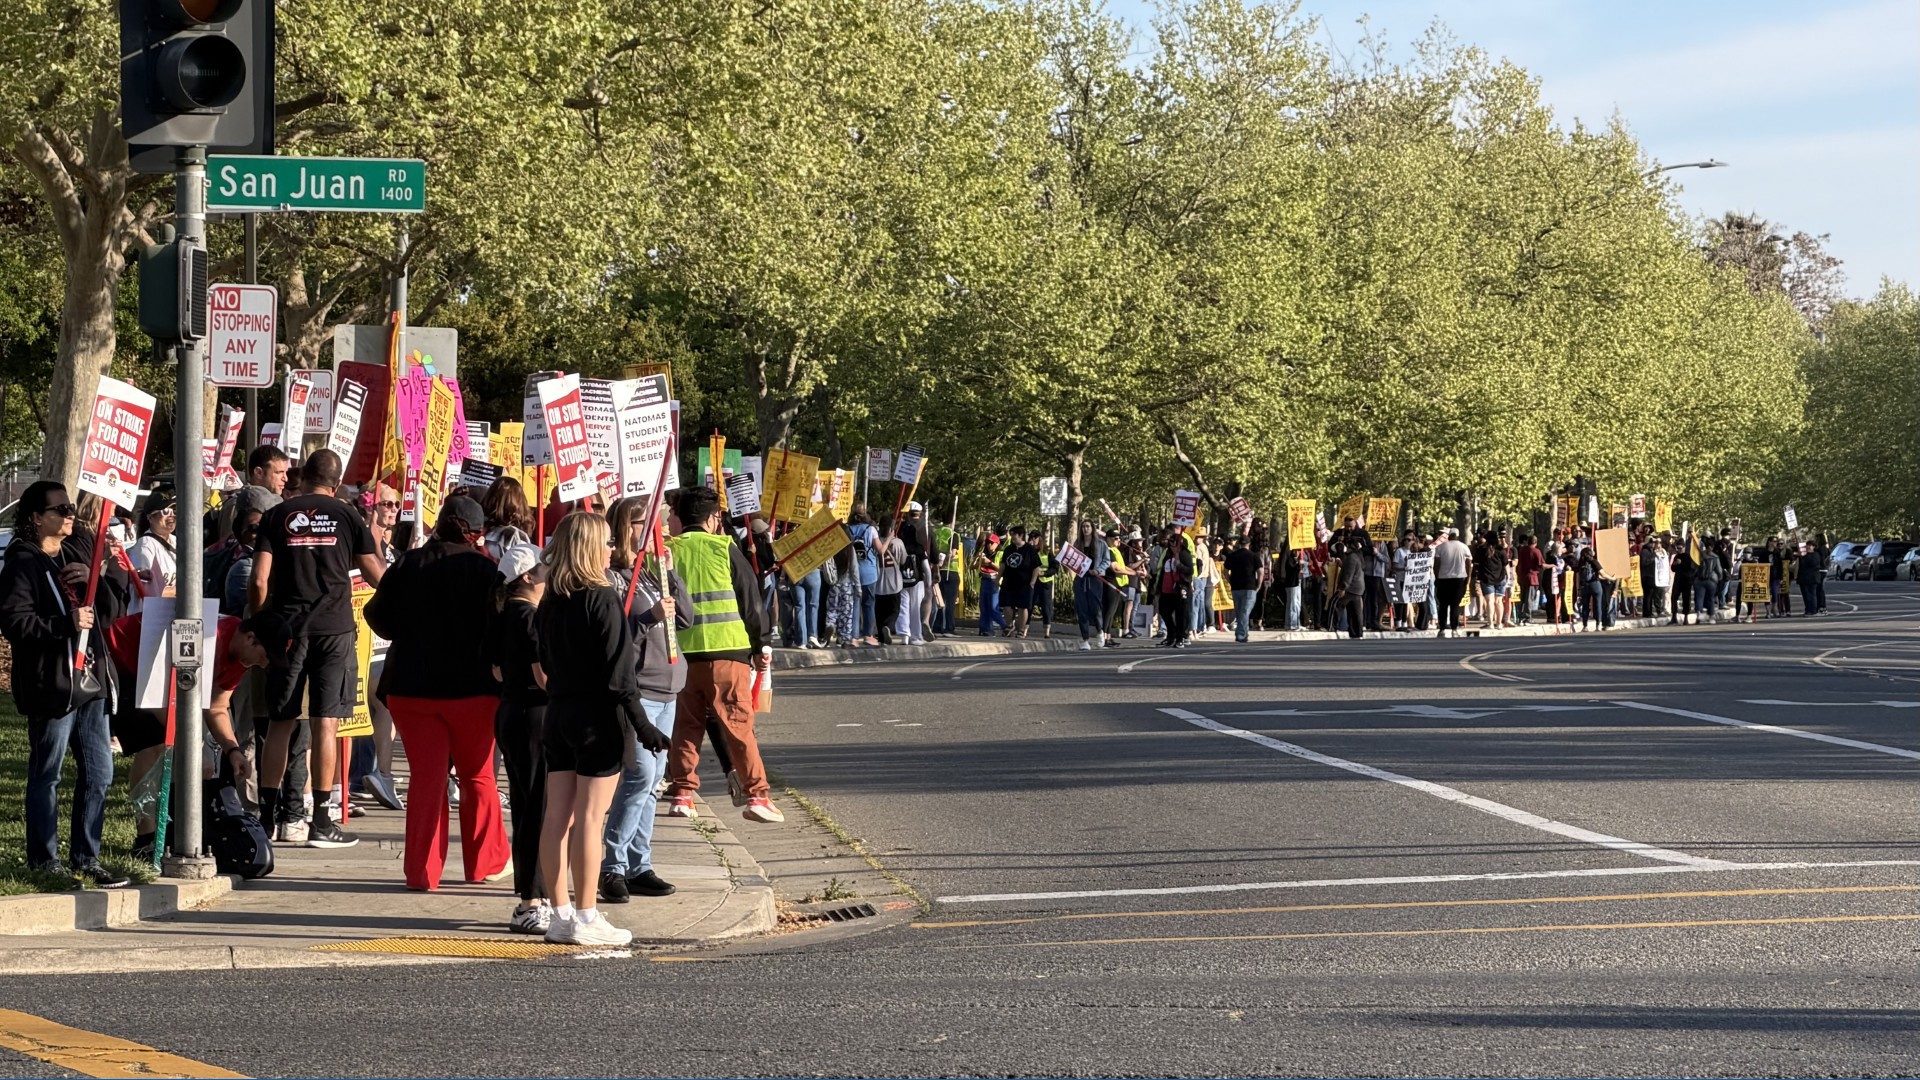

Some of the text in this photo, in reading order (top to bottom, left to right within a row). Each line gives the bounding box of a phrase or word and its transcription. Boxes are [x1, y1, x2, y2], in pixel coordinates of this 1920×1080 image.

[220, 165, 365, 200] San Juan
[389, 169, 406, 183] RD
[381, 187, 412, 201] 1400
[214, 290, 239, 309] NO
[214, 313, 270, 332] STOPPING
[225, 339, 257, 354] ANY
[222, 361, 258, 377] TIME
[310, 387, 330, 399] PPING
[306, 403, 321, 413] NY
[583, 405, 614, 413] TOMAS
[97, 400, 145, 437] ON STRIKE
[306, 417, 323, 427] IME
[548, 407, 562, 426] ON
[585, 414, 614, 422] DENTS
[624, 412, 666, 427] NATOMAS
[97, 422, 138, 455] FOR OUR
[527, 433, 549, 441] NATOMA
[556, 427, 574, 446] FOR
[625, 425, 668, 440] STUDENTS
[90, 441, 138, 477] STUDENTS
[629, 452, 664, 465] THE BES
[871, 450, 881, 458] NO
[464, 477, 490, 486] NATOMA
